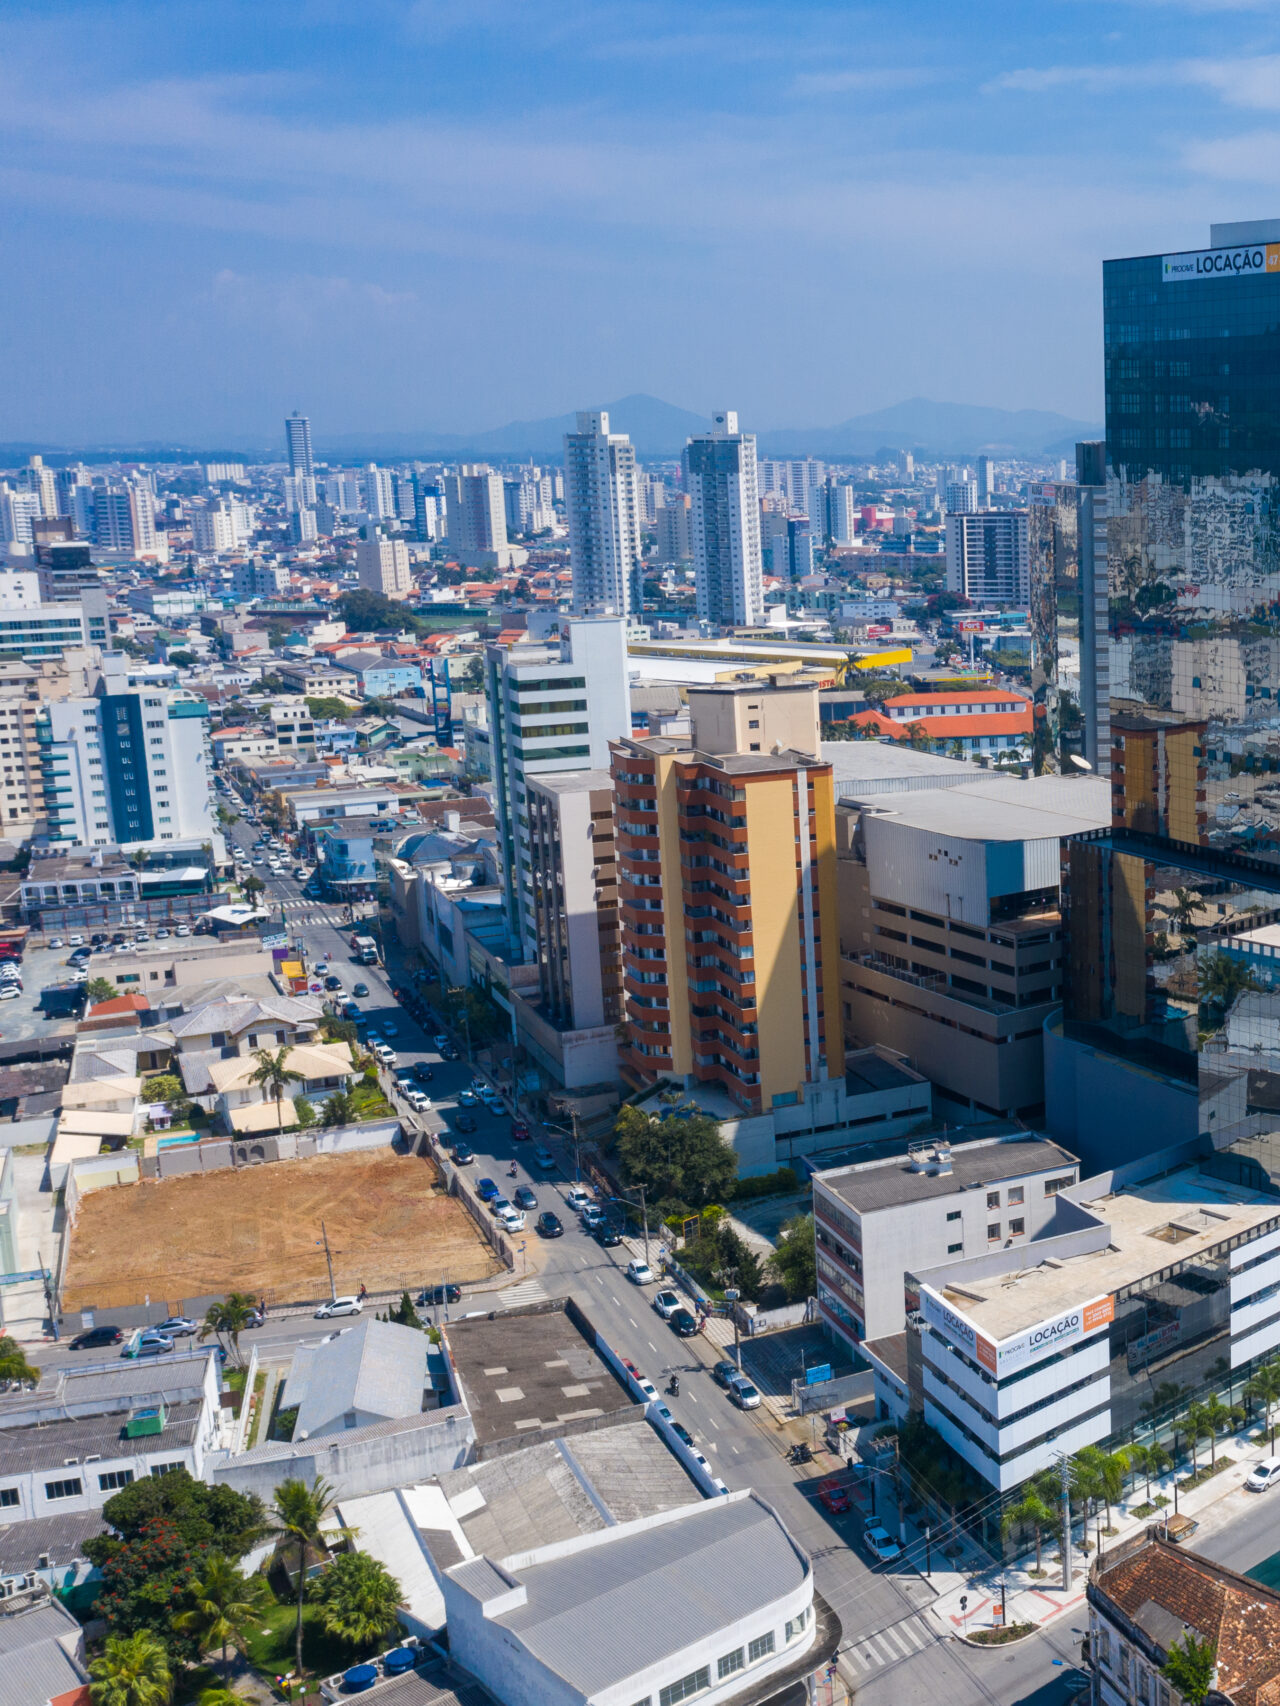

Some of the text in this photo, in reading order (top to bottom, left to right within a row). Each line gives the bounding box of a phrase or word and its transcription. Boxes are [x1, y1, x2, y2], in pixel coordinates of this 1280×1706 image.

[1196, 250, 1263, 275] LOCAÇÃO
[943, 1309, 974, 1341] LOCAÇÃO
[1029, 1316, 1079, 1346] LOCAÇÃO
